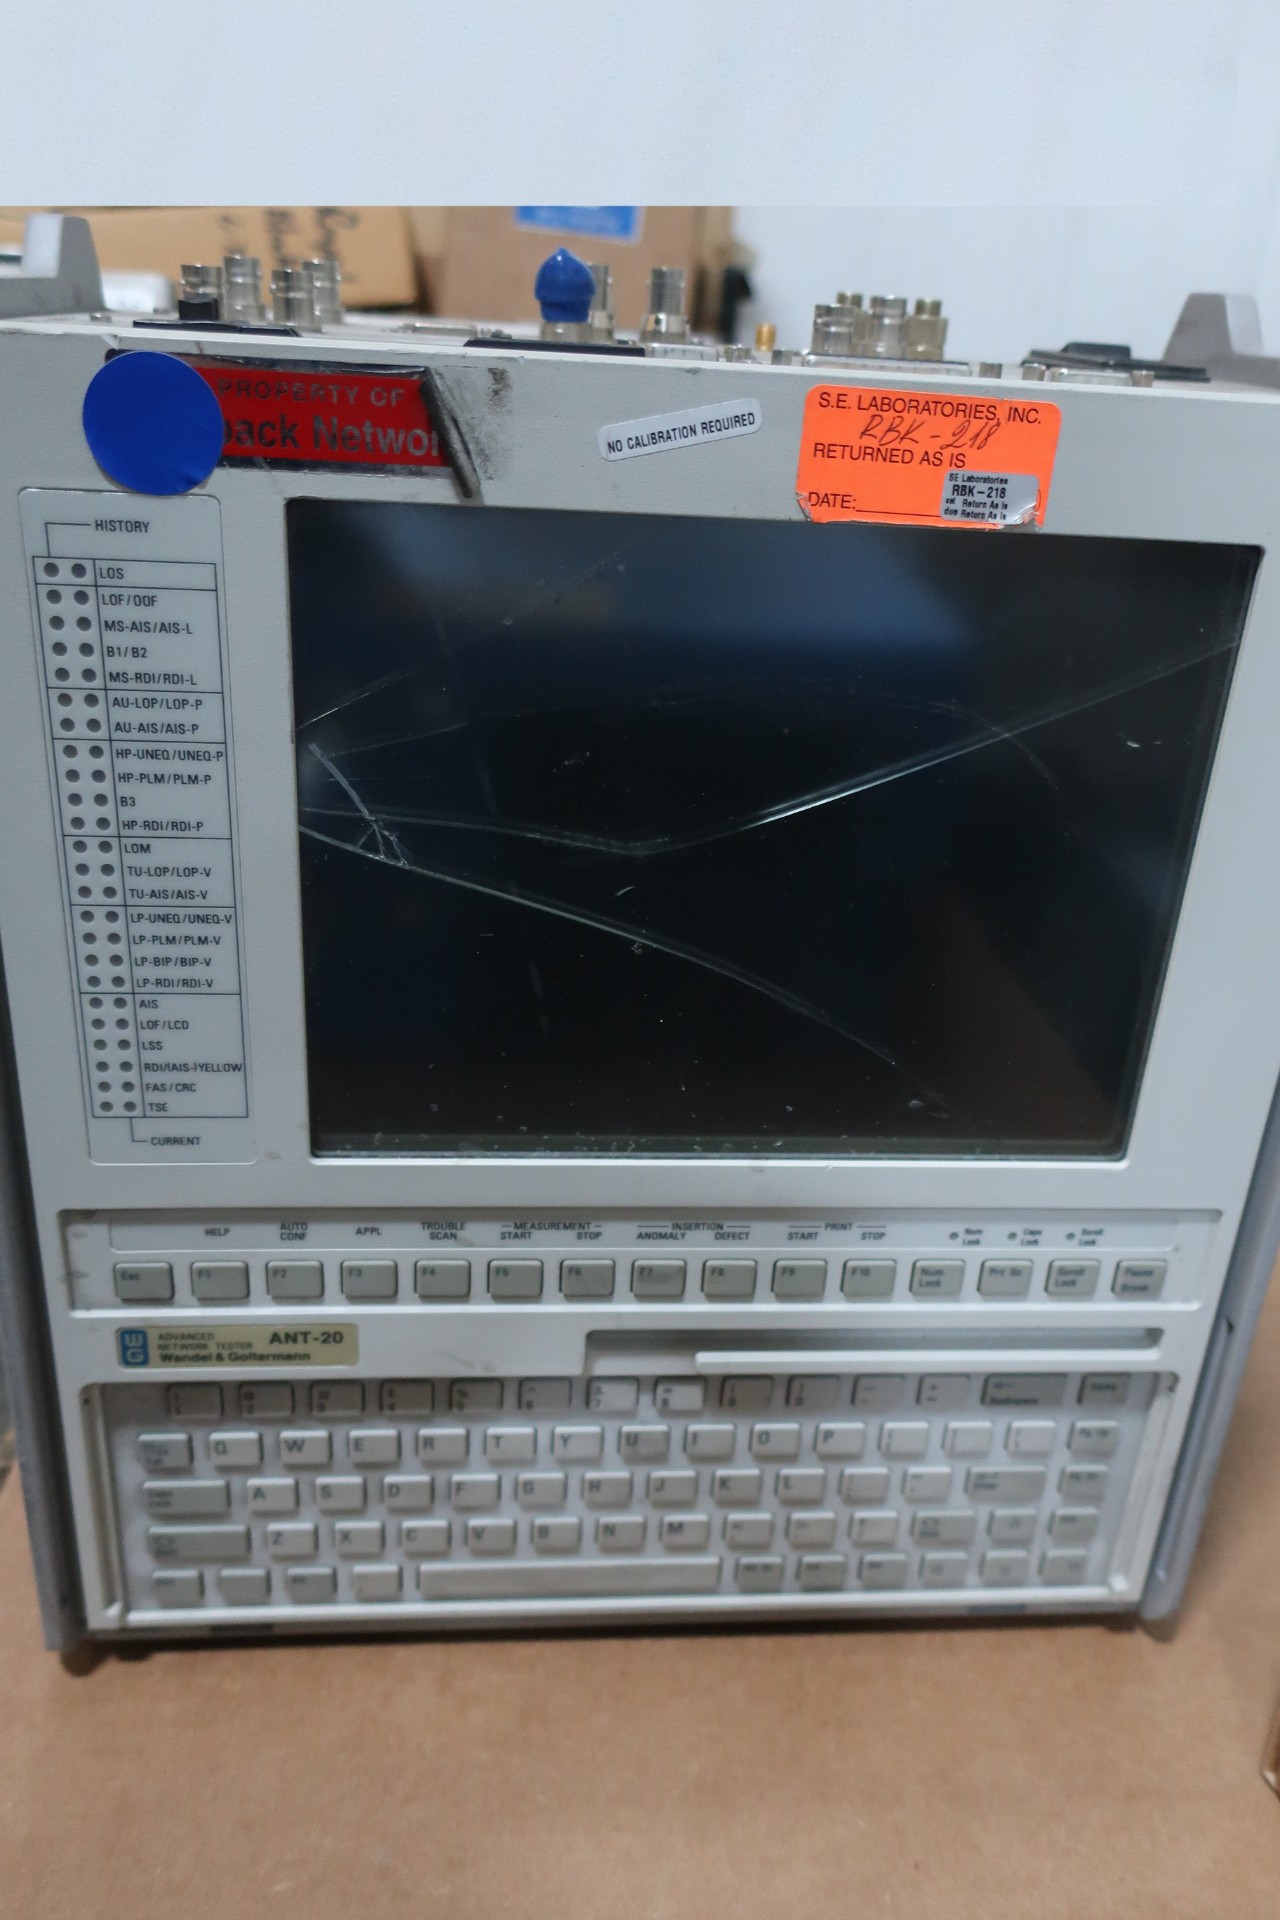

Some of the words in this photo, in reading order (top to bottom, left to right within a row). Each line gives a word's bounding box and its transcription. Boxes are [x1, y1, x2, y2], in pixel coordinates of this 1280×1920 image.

[217, 378, 358, 405] PROPERTY
[370, 387, 404, 407] OF
[818, 391, 851, 409] S.E.
[857, 395, 1001, 422] LABORATORIES,
[1007, 406, 1041, 424] INC.
[607, 439, 623, 454] NO
[627, 424, 698, 450] CALIBRATION
[700, 412, 755, 435] REQUIRED
[813, 442, 914, 464] RETURNED
[918, 451, 943, 467] AS
[949, 453, 966, 468] IS
[949, 473, 959, 482] SE
[962, 474, 1008, 485] Laboratories
[807, 492, 856, 510] DATE:
[962, 499, 987, 508] Return
[989, 500, 999, 509] As
[944, 507, 958, 515] due
[961, 509, 985, 519] Return
[988, 511, 997, 520] As
[95, 519, 150, 533] HISTORY
[99, 567, 124, 580] LOS
[104, 620, 193, 635] MS-AIS/AIS-L
[109, 672, 197, 685] MS-RDI/RDI-L
[112, 697, 203, 710] AU-LOP/LOP-P
[114, 722, 199, 735] AU-AIS/AIS-P
[120, 796, 136, 807] B3
[124, 843, 151, 854] LOM
[139, 1000, 159, 1009] AIS
[142, 1041, 163, 1051] LSS
[148, 1103, 168, 1112] TSE
[151, 1136, 201, 1146] CURRENT
[204, 1228, 230, 1237] HELP
[280, 1223, 308, 1232] AUTO
[356, 1227, 382, 1236] APPL
[421, 1222, 466, 1231] TROUBLE
[513, 1222, 592, 1231] MEASUREMENT
[671, 1222, 724, 1231] INSERTION
[824, 1222, 853, 1231] PRINT
[280, 1232, 307, 1241] CONF
[429, 1231, 457, 1240] SCAN
[500, 1231, 532, 1240] START
[576, 1231, 602, 1240] STOP
[637, 1232, 686, 1240] ANOMALY
[714, 1232, 750, 1240] DEFECT
[787, 1232, 818, 1240] START
[861, 1232, 885, 1240] STOP
[273, 1269, 287, 1278] F2
[423, 1268, 436, 1276] F4
[158, 1333, 215, 1341] ADVANCED
[269, 1331, 344, 1344] ANT-20
[158, 1343, 209, 1351] NETWORK
[216, 1342, 252, 1350] TESTER
[159, 1352, 213, 1362] Wandel
[214, 1352, 224, 1362] &
[355, 1438, 364, 1451] E
[423, 1436, 434, 1449] R
[493, 1435, 504, 1448] T
[561, 1435, 571, 1448] Y
[626, 1434, 638, 1446] U
[285, 1440, 305, 1453] W
[589, 1480, 600, 1492] H
[654, 1479, 664, 1492] J
[719, 1477, 731, 1490] K
[253, 1487, 266, 1500] A
[321, 1486, 331, 1498] S
[388, 1484, 400, 1497] D
[406, 1528, 417, 1541] C
[603, 1524, 616, 1536] N
[272, 1532, 282, 1545] Z
